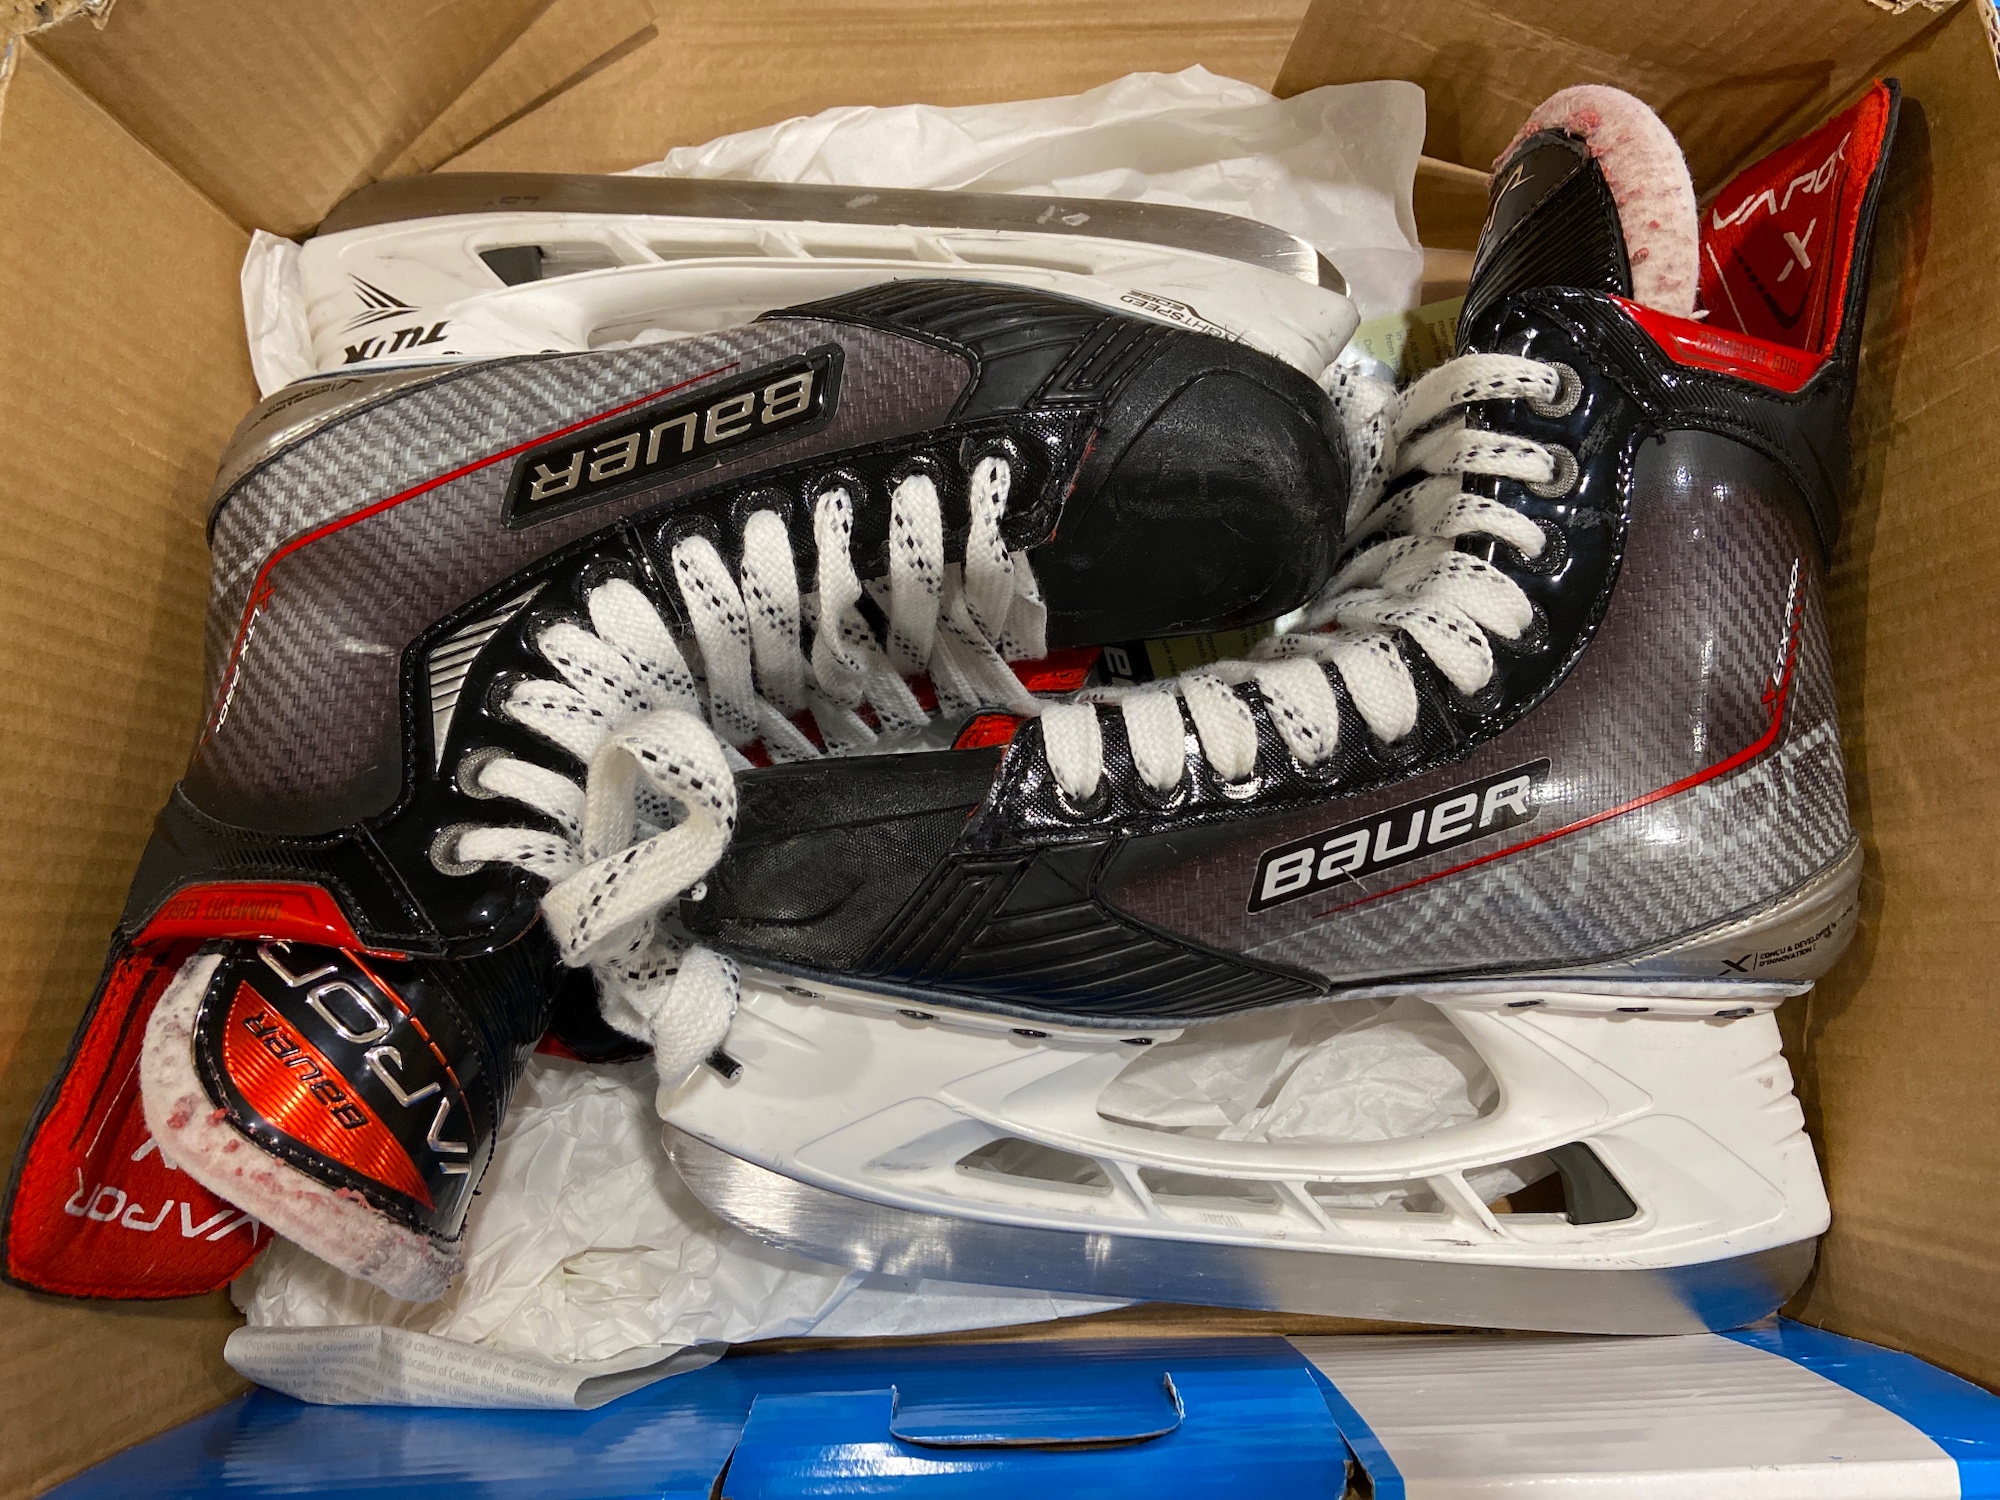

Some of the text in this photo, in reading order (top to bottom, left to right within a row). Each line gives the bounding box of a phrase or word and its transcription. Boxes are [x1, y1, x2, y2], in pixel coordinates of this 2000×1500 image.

[1384, 333, 1396, 356] from
[530, 370, 814, 501] BAUER
[1260, 774, 1531, 901] BAUER
[202, 898, 284, 923] COMFORT
[243, 1010, 369, 1131] BAUER
[244, 1354, 309, 1365] International
[297, 1341, 314, 1352] the
[316, 1341, 374, 1352] Convention
[438, 1365, 448, 1378] of
[449, 1367, 479, 1387] Certain
[480, 1375, 504, 1392] Rules
[506, 1382, 544, 1404] Relating
[414, 1342, 445, 1361] country
[446, 1350, 470, 1365] other
[472, 1355, 492, 1371] than
[494, 1362, 510, 1376] the
[511, 1368, 547, 1388] country
[548, 1377, 562, 1388] of
